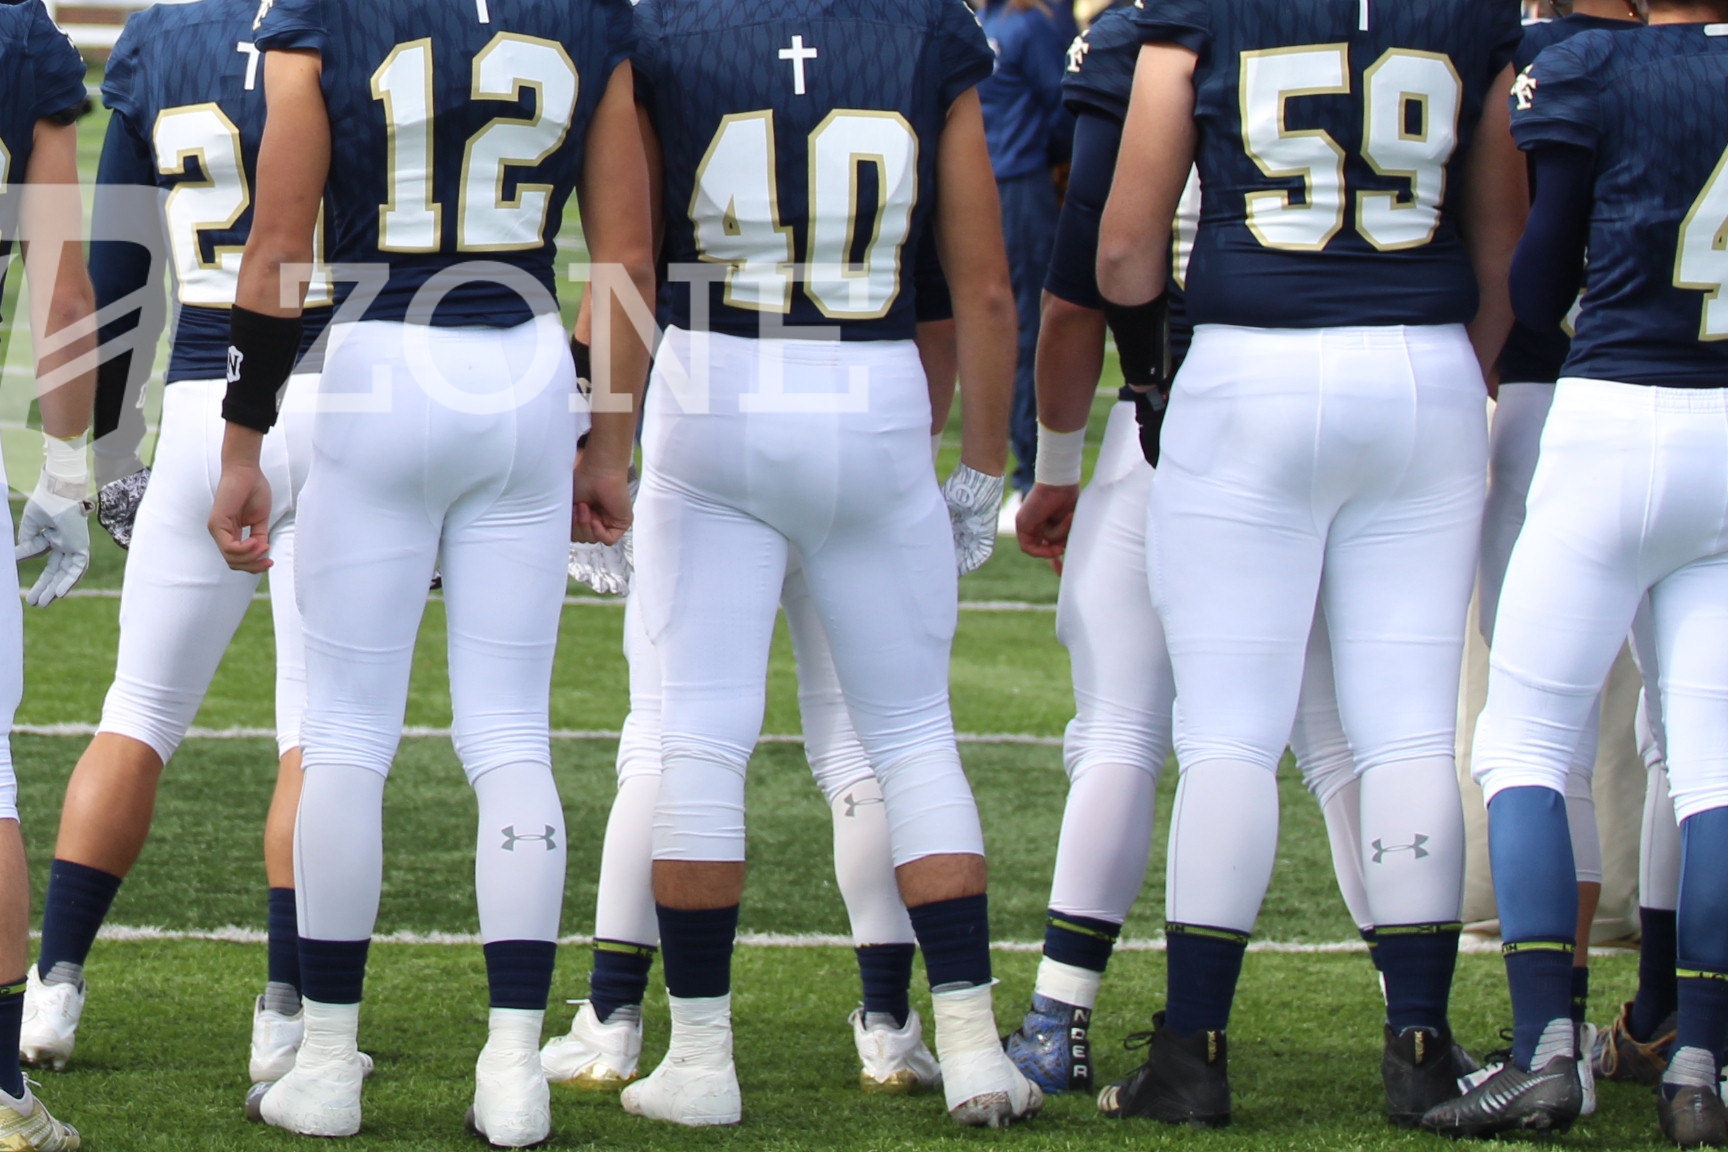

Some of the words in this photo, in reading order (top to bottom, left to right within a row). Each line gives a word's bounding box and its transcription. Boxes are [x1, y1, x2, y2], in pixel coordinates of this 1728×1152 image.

[371, 30, 579, 253] 12
[688, 107, 919, 320] 40
[1238, 42, 1463, 251] 59
[1072, 1009, 1088, 1078] NDER
